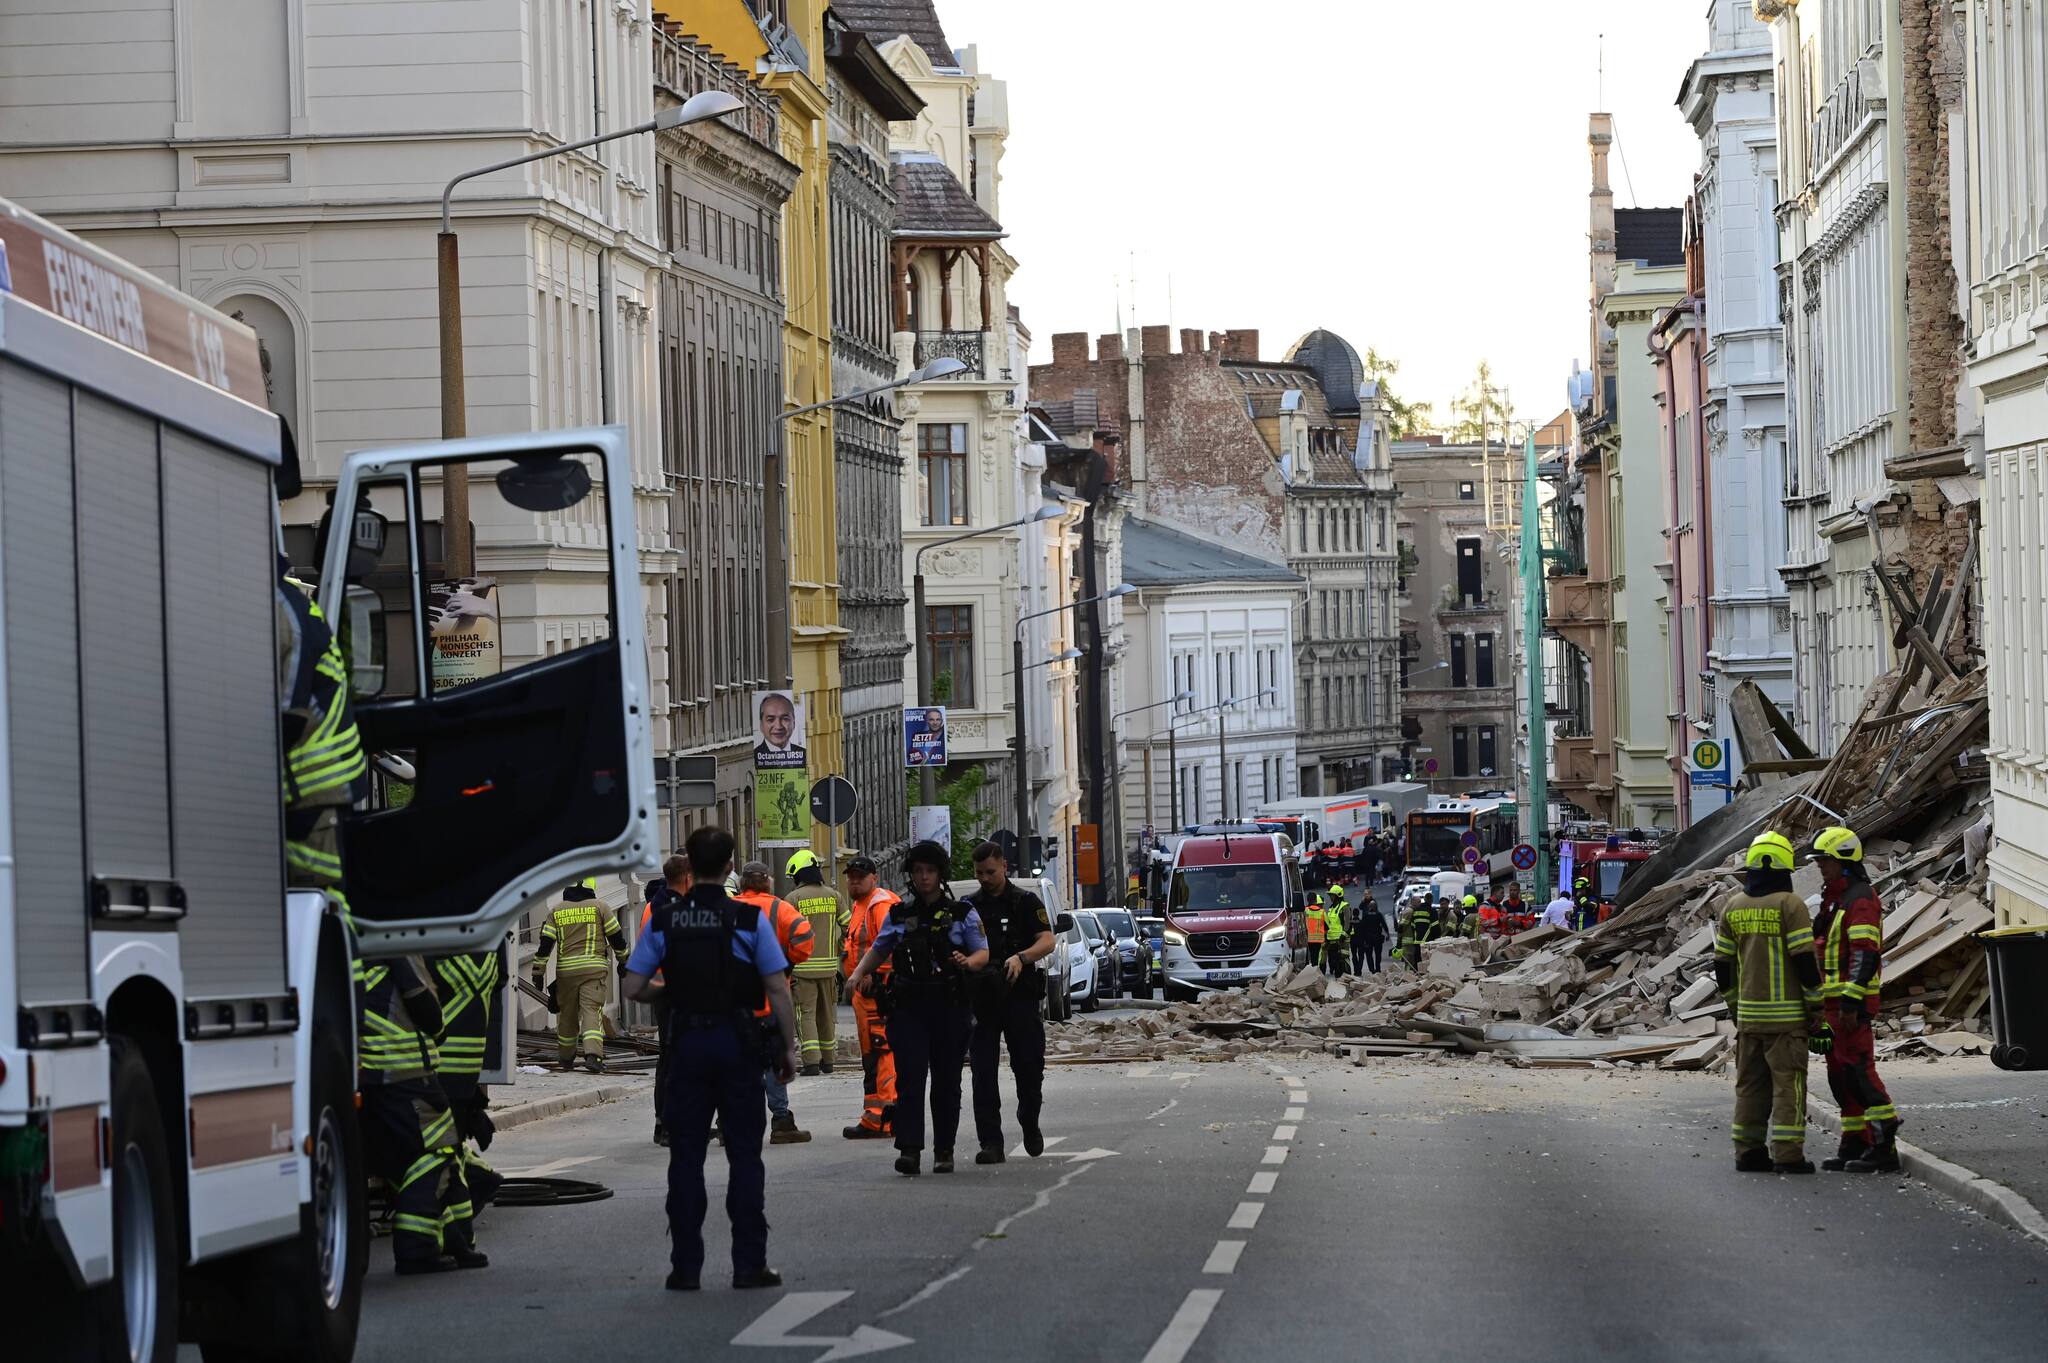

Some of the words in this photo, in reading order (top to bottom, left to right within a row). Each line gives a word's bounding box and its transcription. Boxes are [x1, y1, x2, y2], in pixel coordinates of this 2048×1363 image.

[42, 239, 149, 355] FEUERWEHR
[440, 634, 480, 643] PHILHAR
[440, 641, 494, 651] MONISCHES
[440, 650, 482, 659] KONZERT
[432, 678, 485, 689] 05.06.20
[912, 733, 933, 742] JETZT
[757, 752, 786, 760] Octavian
[786, 751, 804, 759] URSU
[758, 773, 768, 784] 23
[769, 773, 785, 784] NFF
[554, 906, 597, 919] FREIWILLIGE
[1185, 915, 1262, 923] FEUERWEHR
